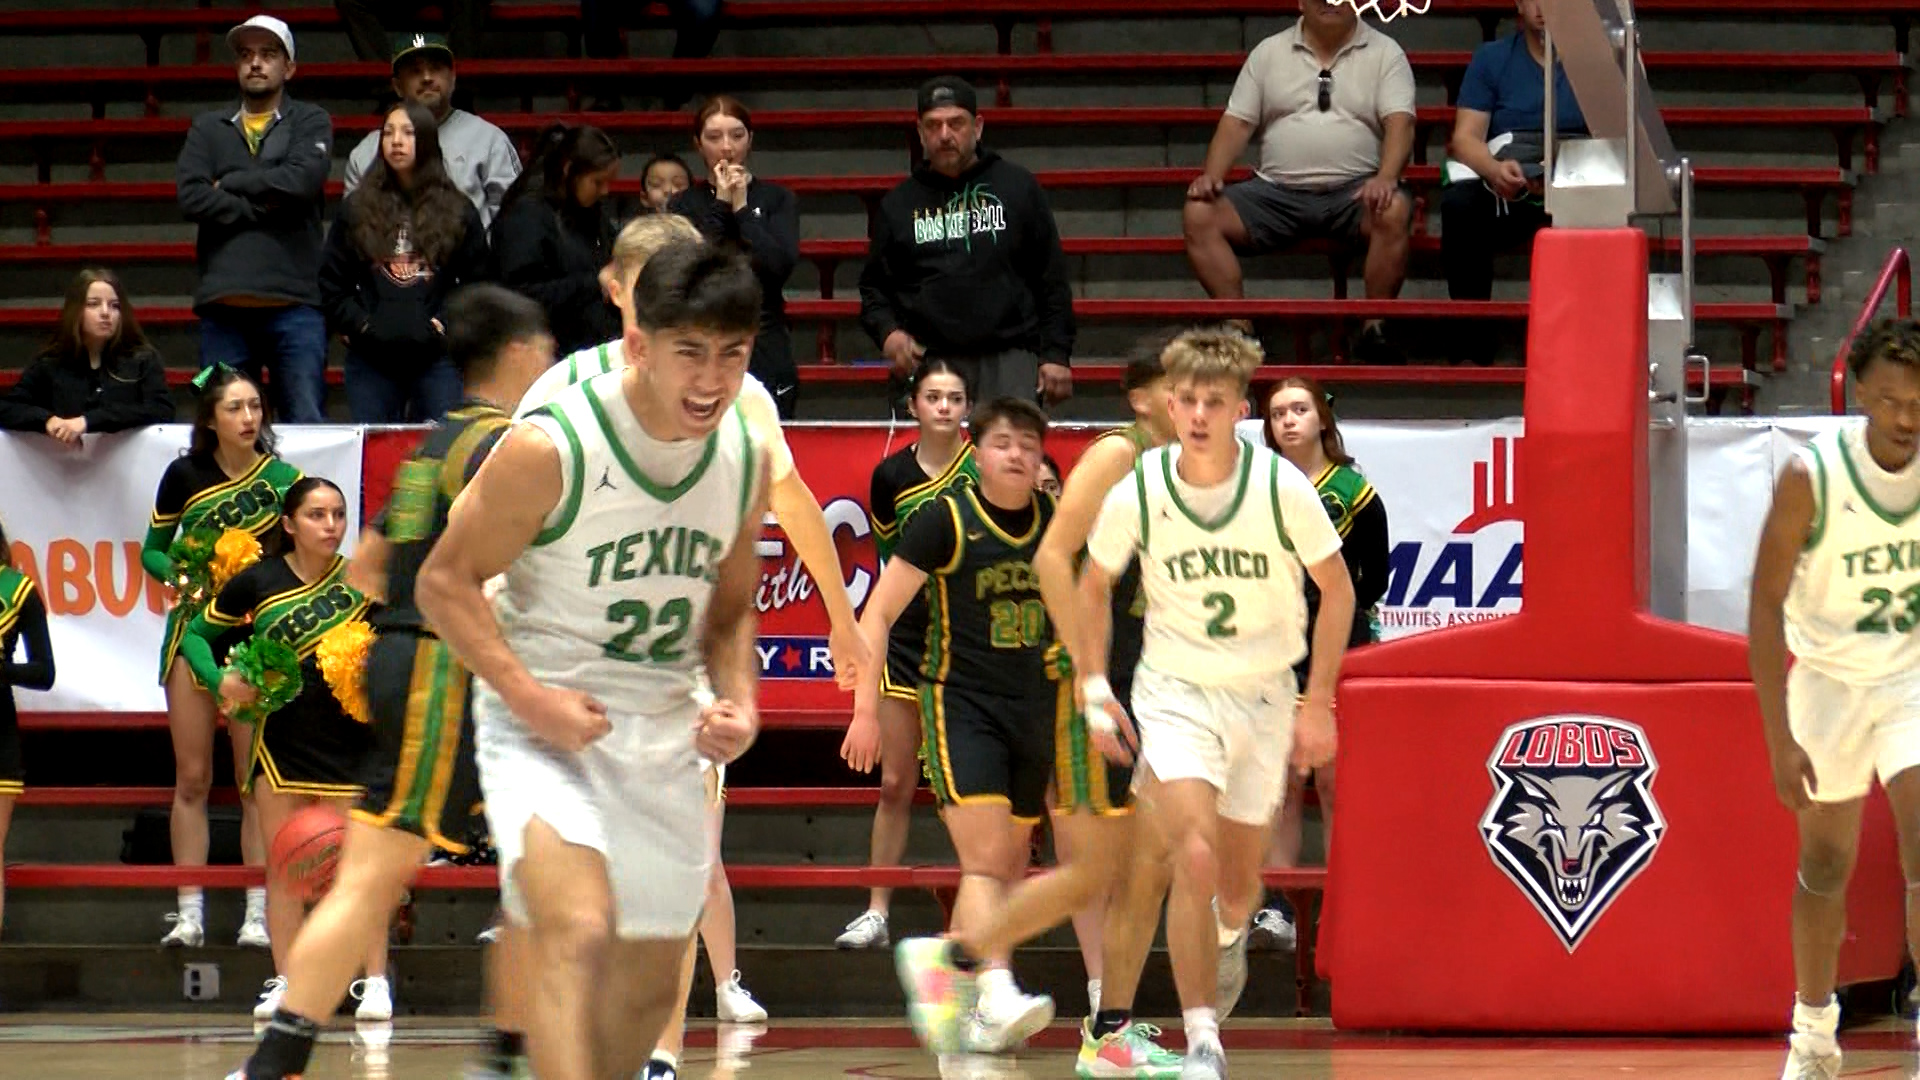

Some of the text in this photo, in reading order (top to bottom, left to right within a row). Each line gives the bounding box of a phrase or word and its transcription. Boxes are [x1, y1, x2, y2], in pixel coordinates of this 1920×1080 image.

[914, 205, 1007, 244] BASKETBALL
[1164, 546, 1269, 582] TEXICO
[1841, 538, 1920, 578] TEXI
[603, 597, 693, 662] 22
[989, 599, 1045, 648] 20
[1203, 591, 1238, 639] 2
[1856, 582, 1920, 633] 23
[1499, 722, 1646, 768] LOBOS
